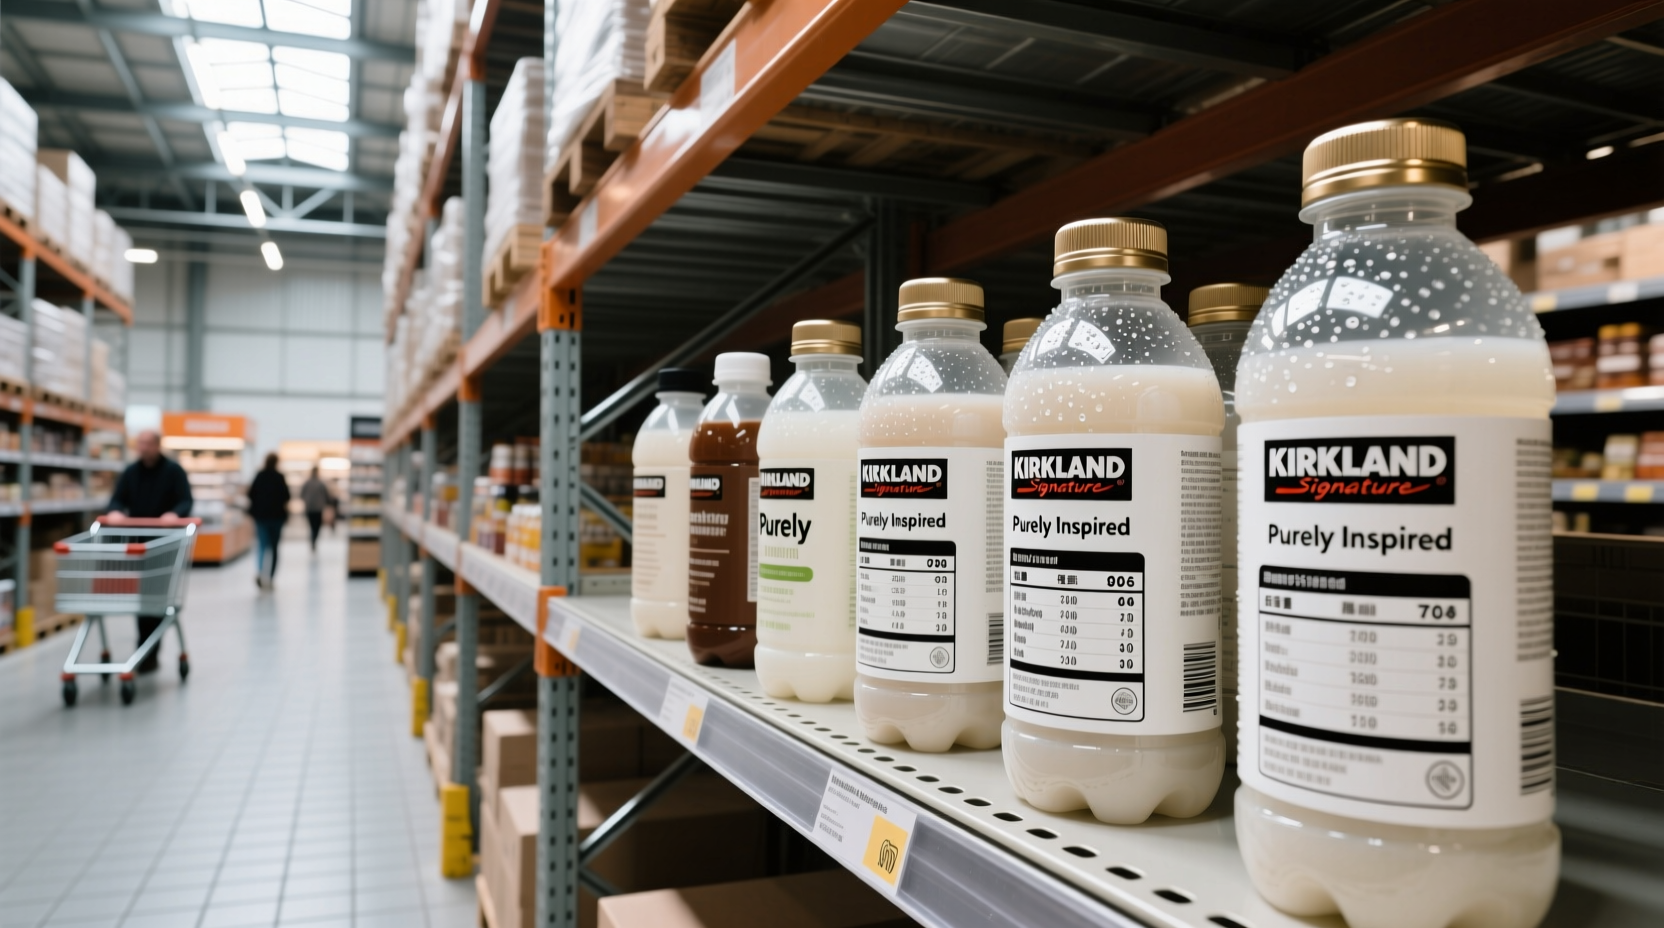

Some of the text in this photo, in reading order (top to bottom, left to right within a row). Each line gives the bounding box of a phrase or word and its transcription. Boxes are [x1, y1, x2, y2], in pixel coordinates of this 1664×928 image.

[862, 464, 942, 483] KIRKLAND
[1014, 455, 1125, 479] KIRKLAND
[1269, 445, 1447, 478] KIRKLAND
[1017, 478, 1114, 497] Signature
[1275, 477, 1431, 500] Signature
[760, 512, 811, 545] Purely
[861, 511, 946, 531] Purely Inspired
[1013, 515, 1130, 539] Purely Inspired
[1269, 523, 1452, 555] Purely Inspired
